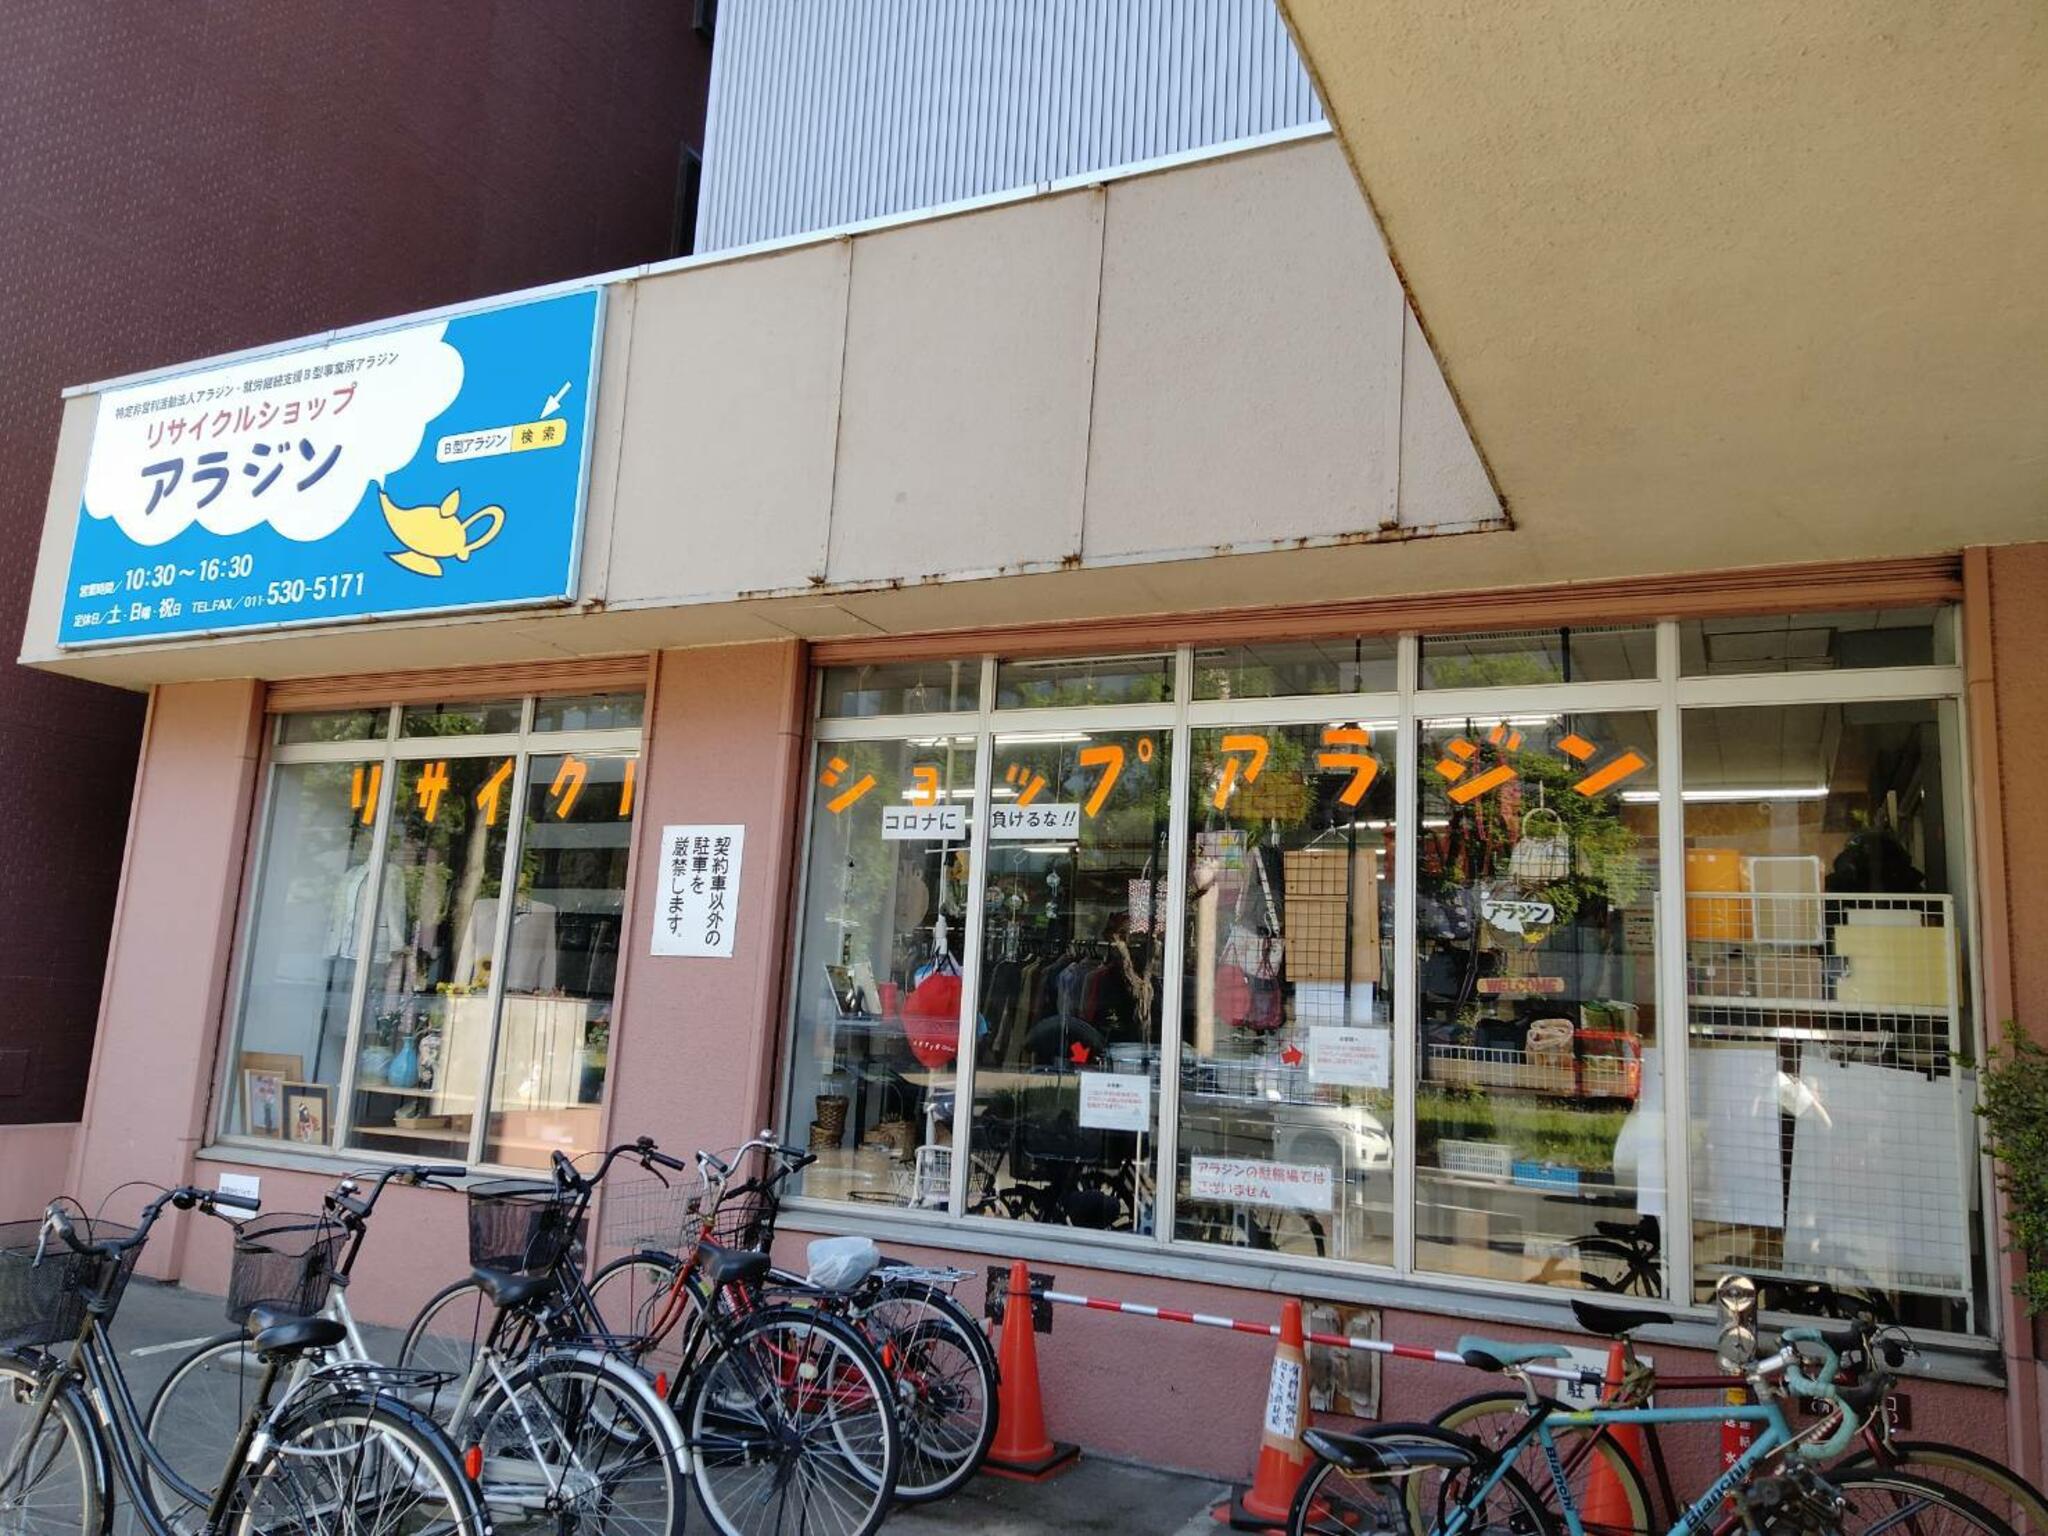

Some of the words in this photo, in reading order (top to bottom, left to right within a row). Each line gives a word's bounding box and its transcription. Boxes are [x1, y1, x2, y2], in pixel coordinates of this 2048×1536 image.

[146, 381, 358, 450] リサイクルショップ
[444, 434, 507, 455] B型アラジン
[140, 438, 343, 516] アラジン
[885, 812, 957, 831] コロナに
[690, 836, 710, 894] 駐車を
[704, 836, 731, 946] 契約車以外の
[1486, 903, 1549, 921] アラジン
[1485, 978, 1560, 992] WELCOME
[1546, 1446, 1575, 1511] Bianchi
[1684, 1463, 1747, 1530] Bianchi
